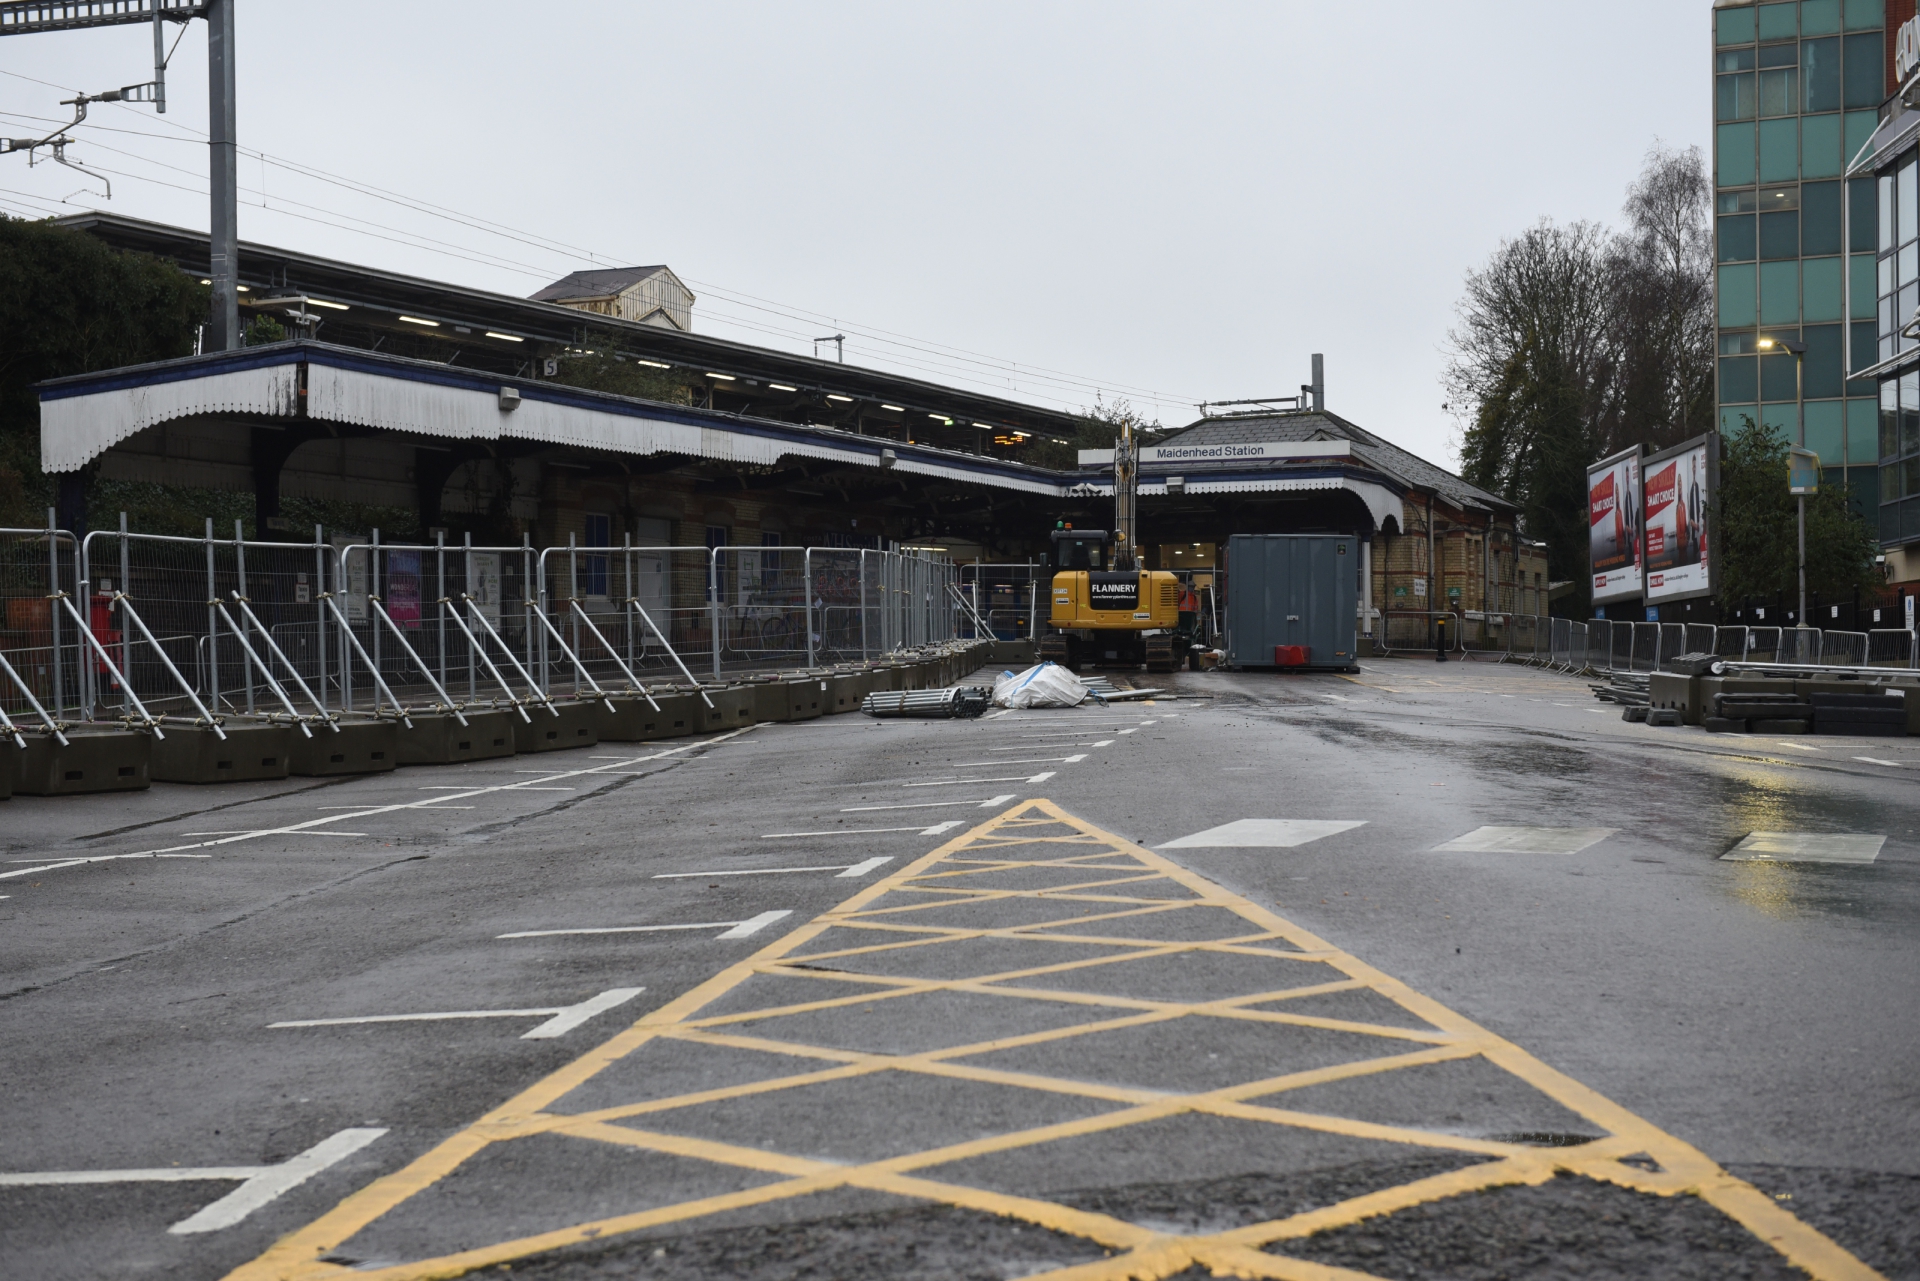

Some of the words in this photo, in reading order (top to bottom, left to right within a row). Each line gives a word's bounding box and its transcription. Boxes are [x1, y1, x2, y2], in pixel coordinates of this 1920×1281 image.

[547, 361, 555, 375] 5
[1157, 446, 1222, 459] Maidenhead
[1224, 446, 1264, 457] Station
[1647, 492, 1660, 507] SMART
[1660, 487, 1675, 504] CHOICE
[1092, 584, 1137, 593] FLANNERY
